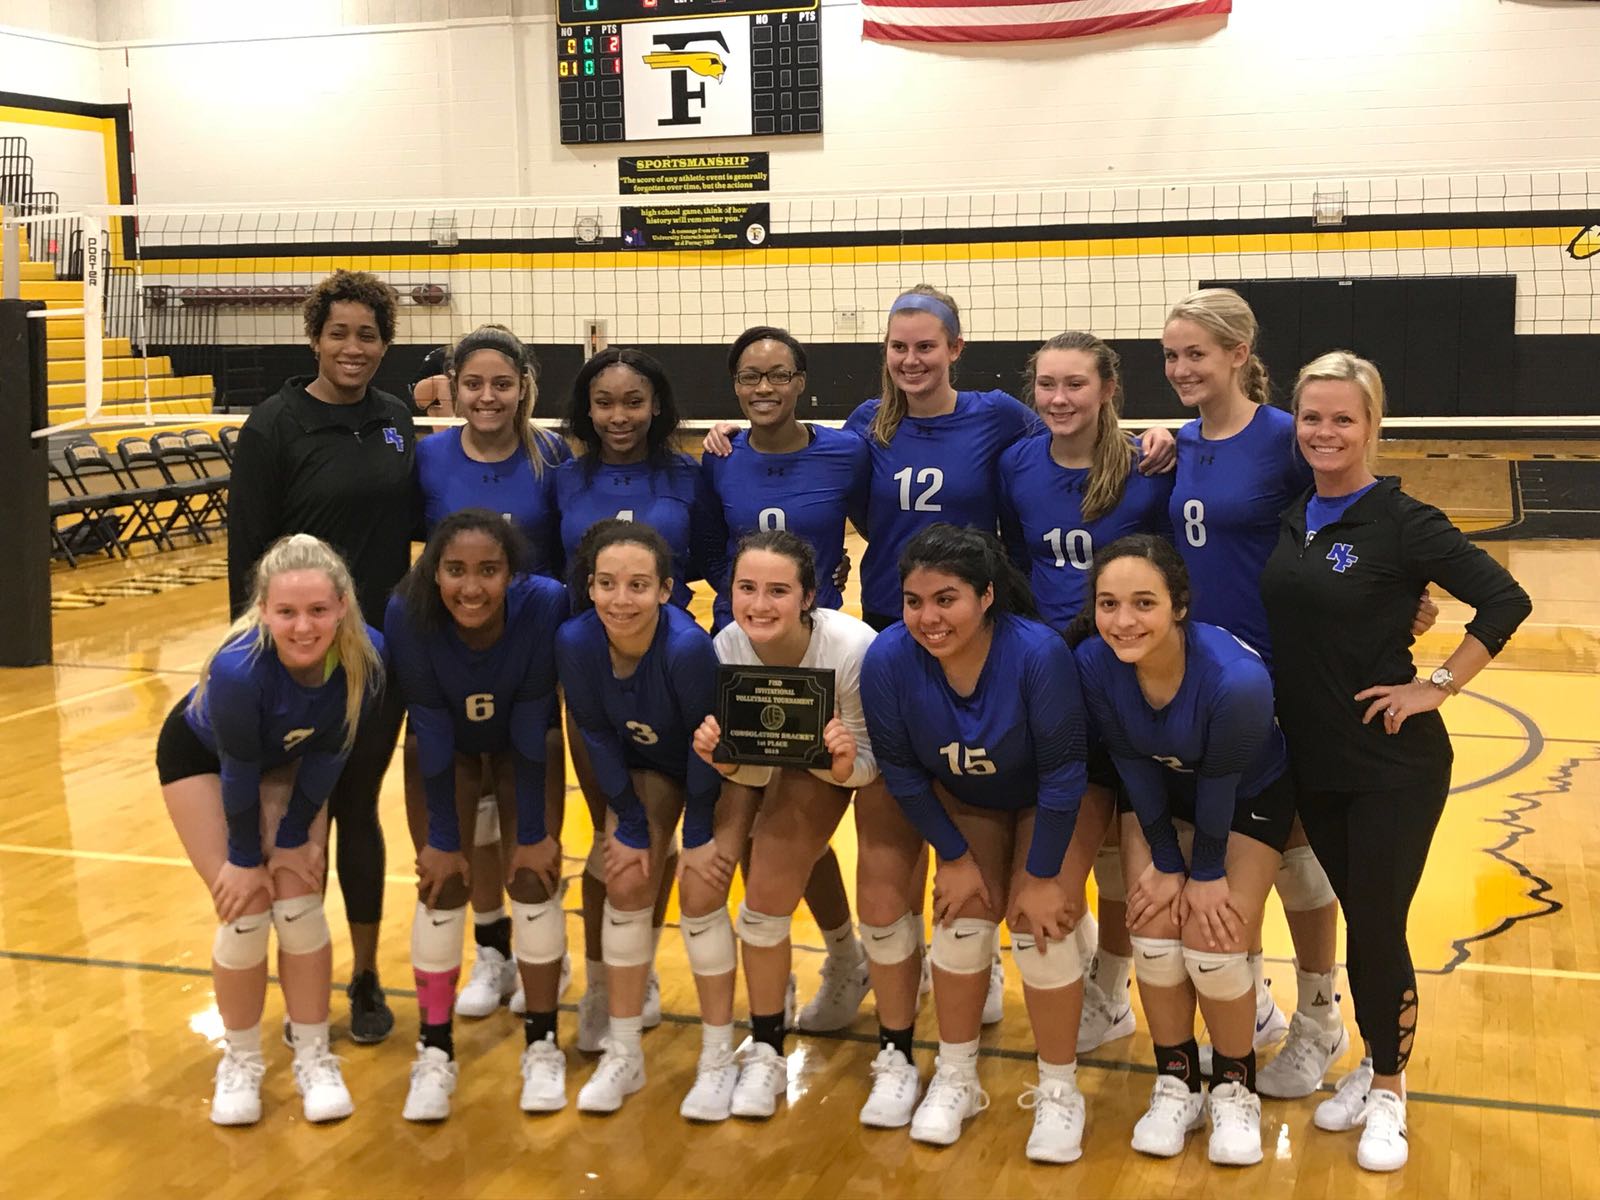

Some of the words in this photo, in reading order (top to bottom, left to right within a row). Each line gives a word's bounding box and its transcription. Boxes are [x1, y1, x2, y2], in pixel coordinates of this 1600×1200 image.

[756, 14, 769, 24] NO
[782, 13, 788, 23] F
[799, 11, 816, 22] PTS
[561, 27, 573, 37] NO
[585, 26, 591, 36] F
[601, 24, 617, 34] PTS
[610, 36, 619, 52] 2
[585, 60, 595, 75] 0
[636, 156, 750, 169] SPORTSMANSHIP
[656, 175, 665, 183] of
[665, 176, 678, 184] any
[679, 174, 705, 182] athletic
[734, 172, 767, 182] generally
[633, 184, 666, 193] forgotten
[702, 182, 714, 190] but
[727, 181, 753, 189] actions
[641, 208, 657, 217] high
[657, 208, 680, 216] school
[703, 206, 723, 214] think
[724, 206, 732, 214] of
[732, 206, 748, 214] how
[646, 216, 671, 225] history
[687, 215, 723, 223] remember
[88, 237, 97, 286] PORTER
[893, 466, 944, 512] 12
[1183, 499, 1207, 547] 8
[1042, 527, 1094, 571] 10
[465, 693, 496, 722] 6
[625, 720, 659, 745] 3
[781, 732, 816, 741] BRACKET
[767, 740, 789, 748] PLACE
[939, 741, 998, 776] 15
